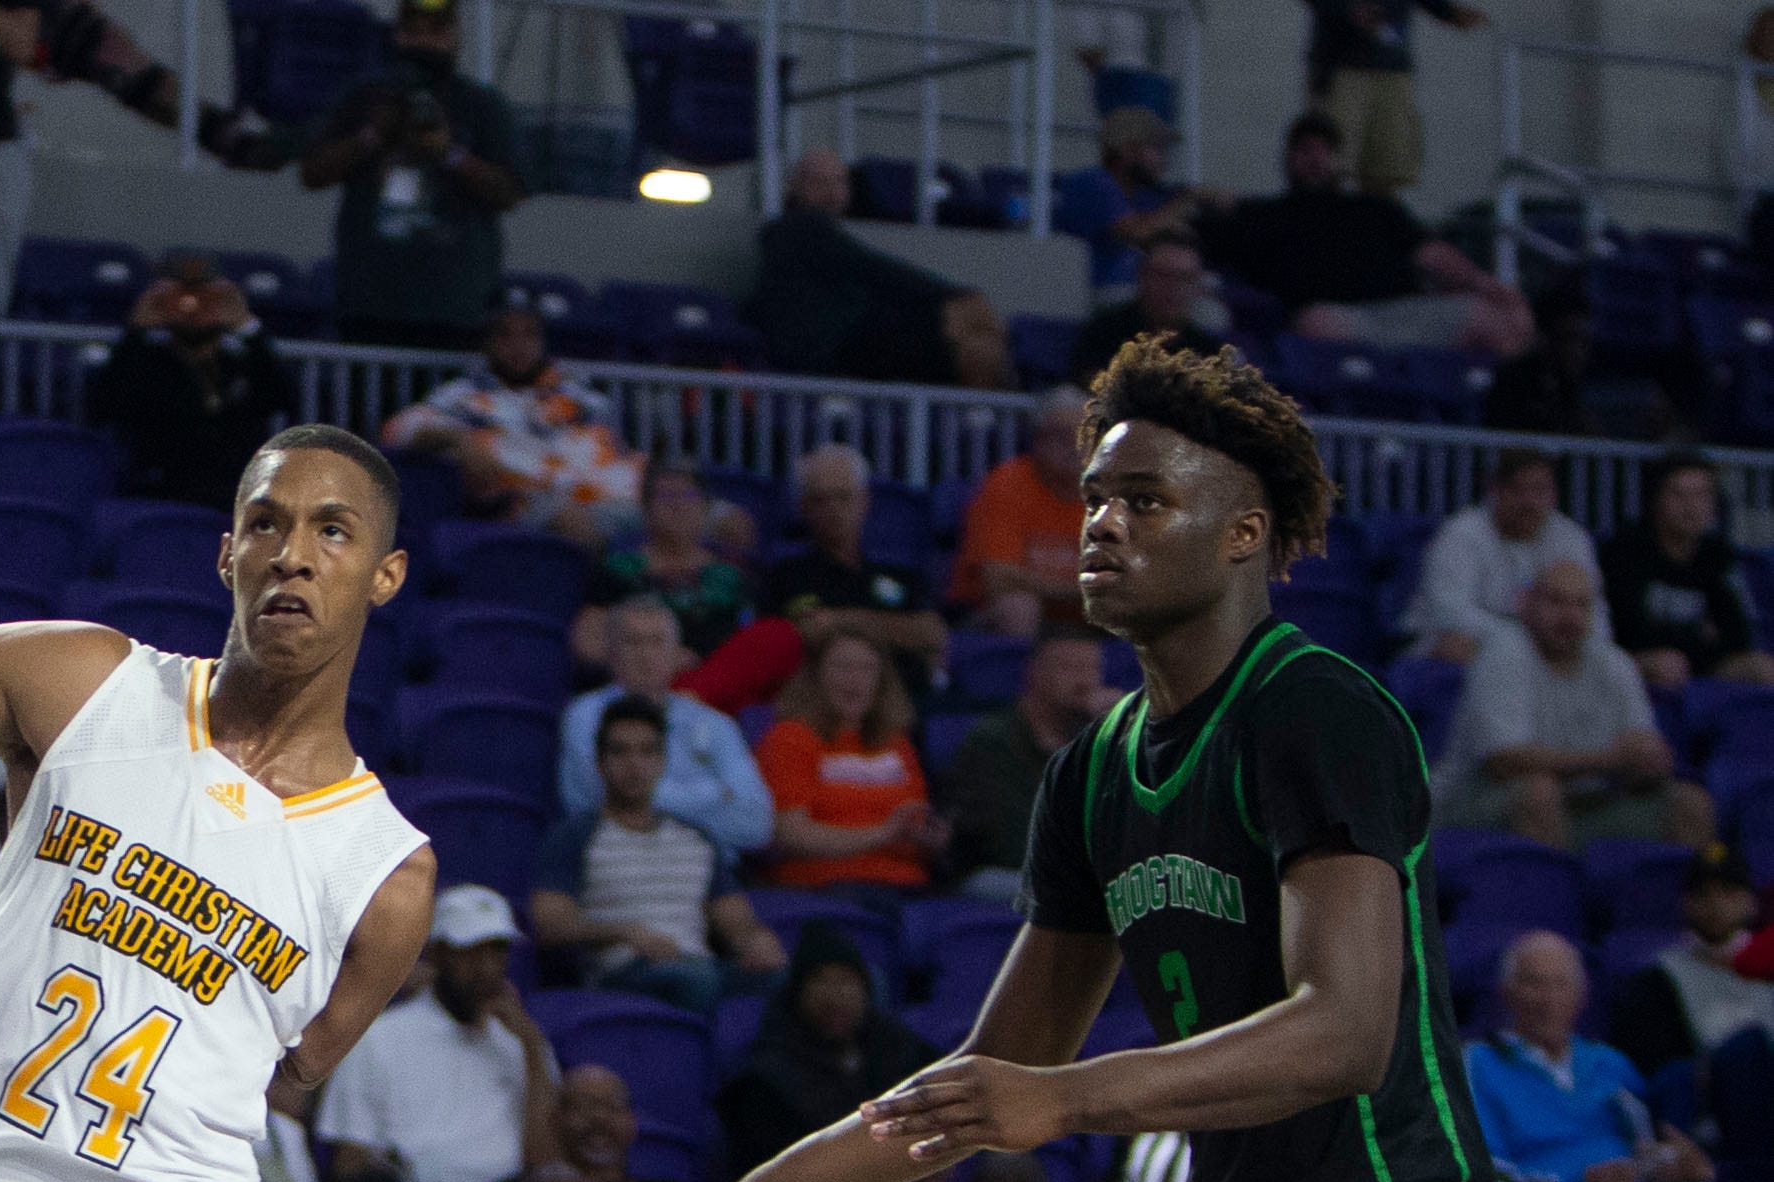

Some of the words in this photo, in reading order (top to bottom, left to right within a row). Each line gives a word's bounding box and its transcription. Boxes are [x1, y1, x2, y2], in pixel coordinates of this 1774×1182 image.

[34, 804, 122, 875] LIFE
[112, 843, 309, 994] CHRISTIAN
[51, 877, 238, 1005] ACADEMY
[1105, 854, 1246, 936] HOCTAW
